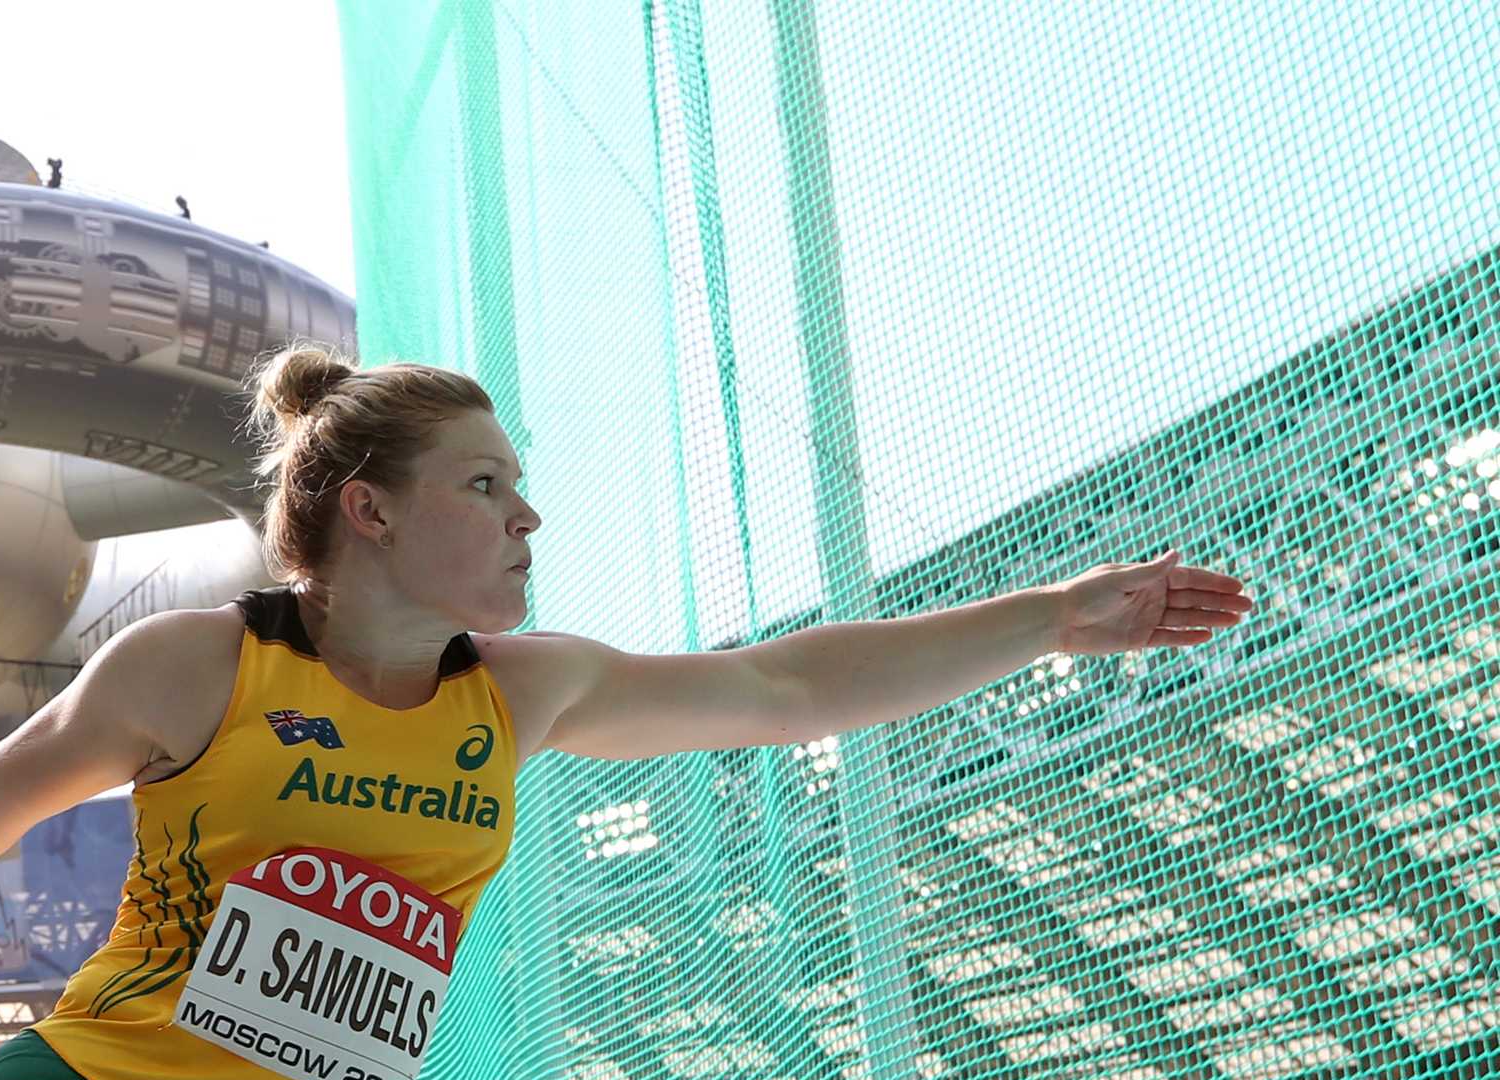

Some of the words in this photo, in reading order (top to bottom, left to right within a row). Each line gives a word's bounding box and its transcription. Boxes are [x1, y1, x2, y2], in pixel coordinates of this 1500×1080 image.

[277, 757, 500, 830] Australia
[206, 907, 252, 985] D.
[260, 928, 436, 1059] SAMUELS
[181, 1001, 339, 1079] MOSCOW
